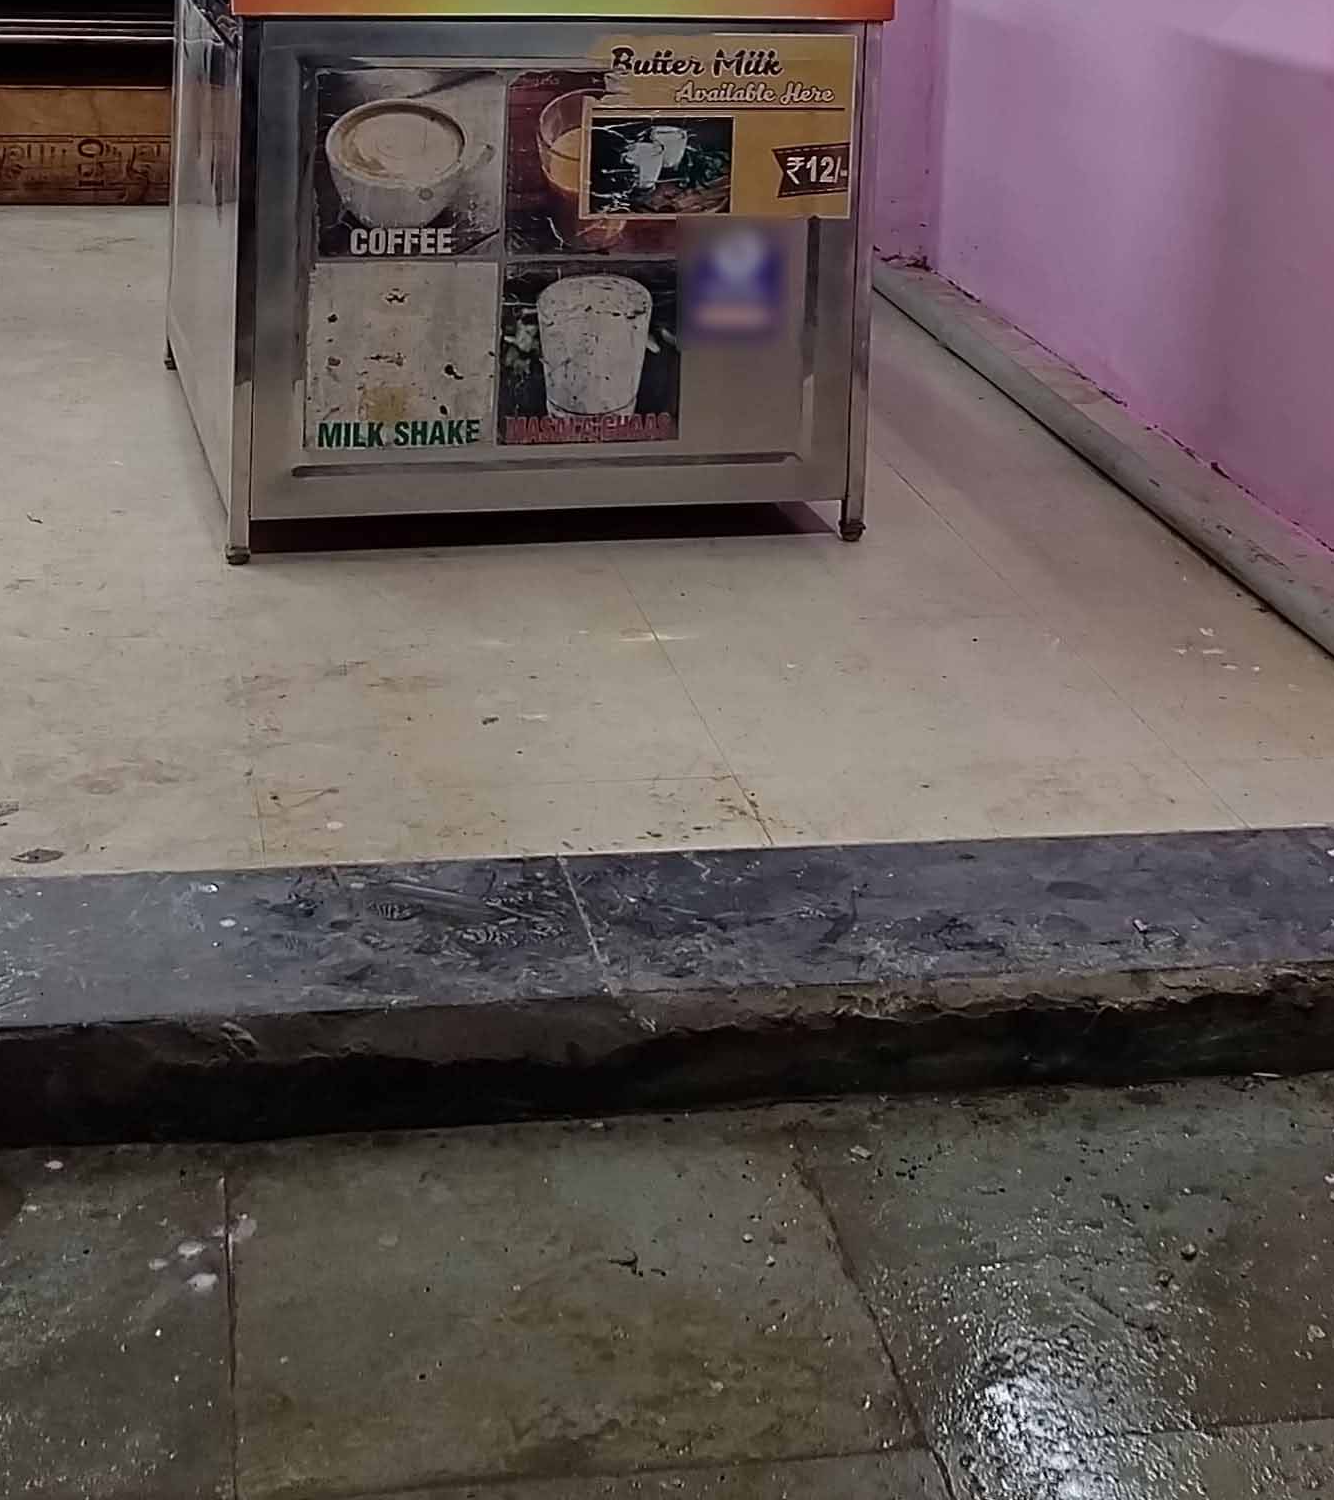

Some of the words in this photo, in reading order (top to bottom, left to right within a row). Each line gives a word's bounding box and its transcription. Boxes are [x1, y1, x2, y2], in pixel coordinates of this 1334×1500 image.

[611, 46, 704, 77] Butter
[713, 48, 783, 77] Milk
[675, 80, 777, 104] Available
[780, 82, 835, 104] Here
[350, 227, 453, 256] COFFEE
[318, 421, 384, 448] MILK
[394, 418, 482, 446] SHAKE
